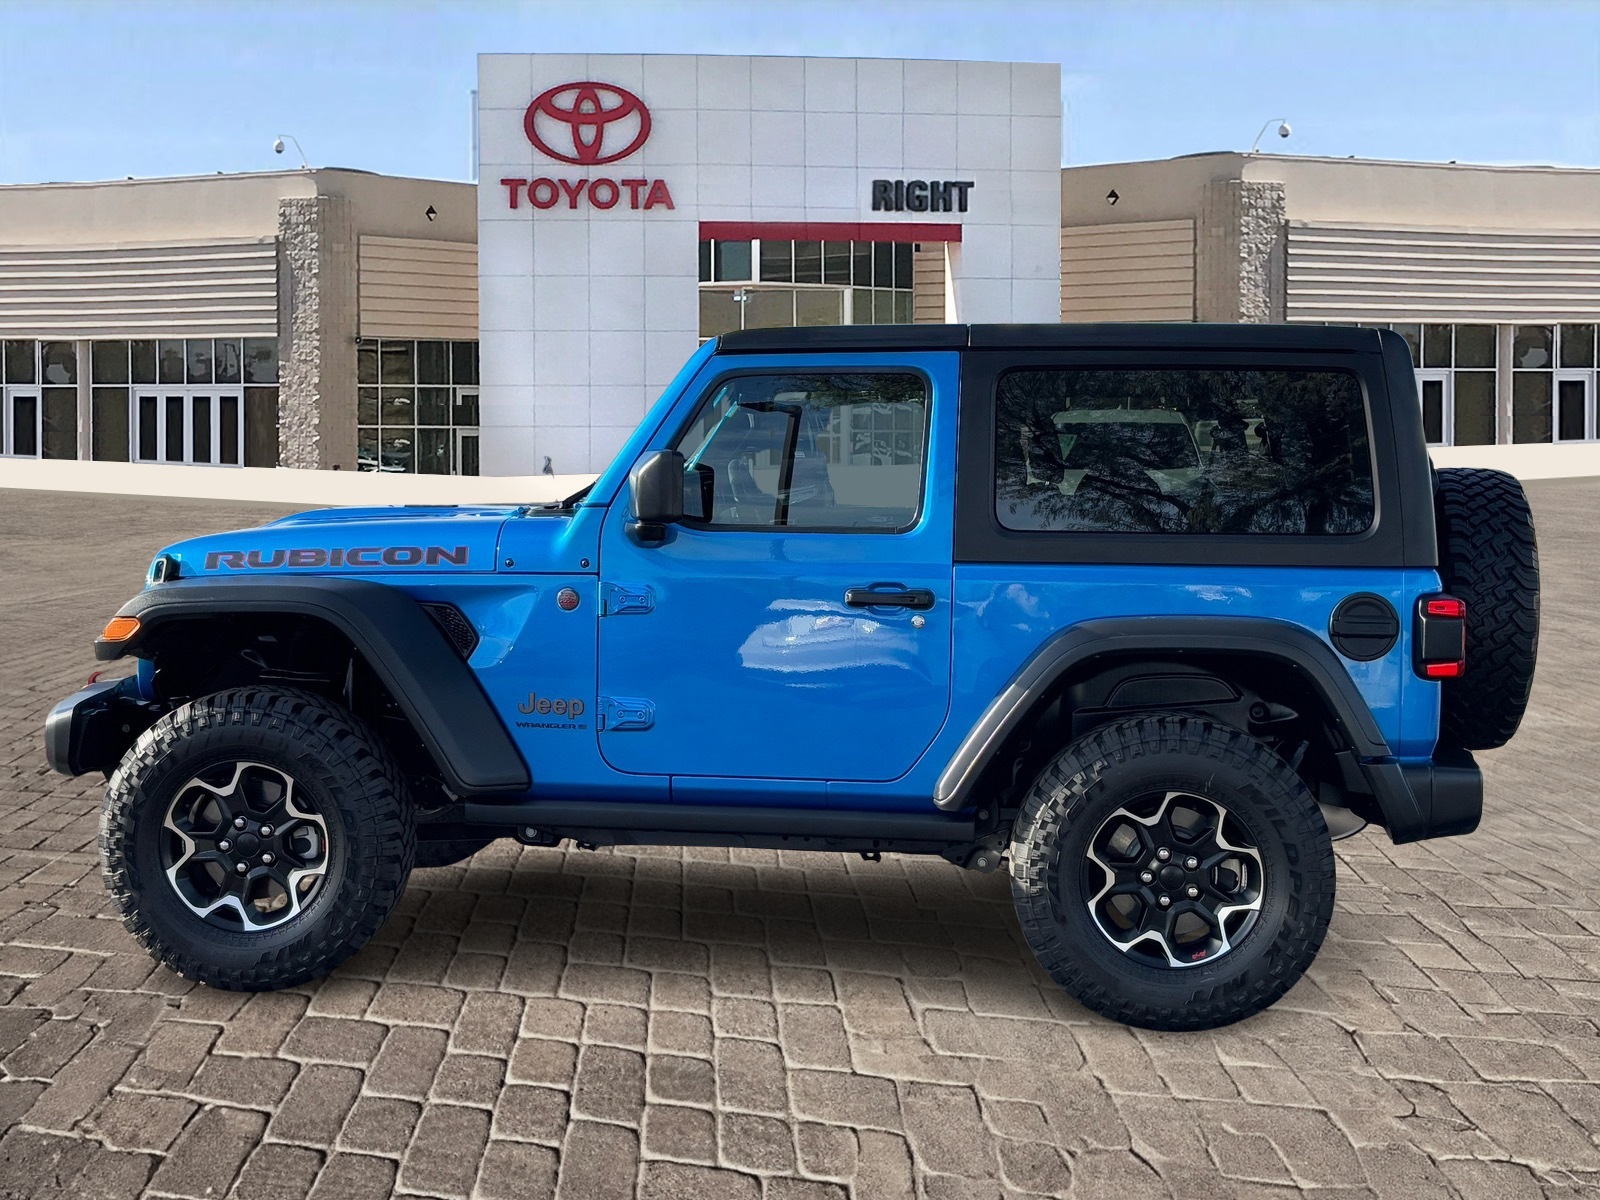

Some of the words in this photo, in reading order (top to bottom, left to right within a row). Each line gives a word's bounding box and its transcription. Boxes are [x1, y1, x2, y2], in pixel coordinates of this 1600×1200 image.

[500, 178, 676, 210] TOYOTA
[872, 180, 975, 212] RIGHT
[204, 546, 469, 570] RUBICON
[518, 692, 585, 719] Jeep
[516, 721, 577, 730] WRANGLER
